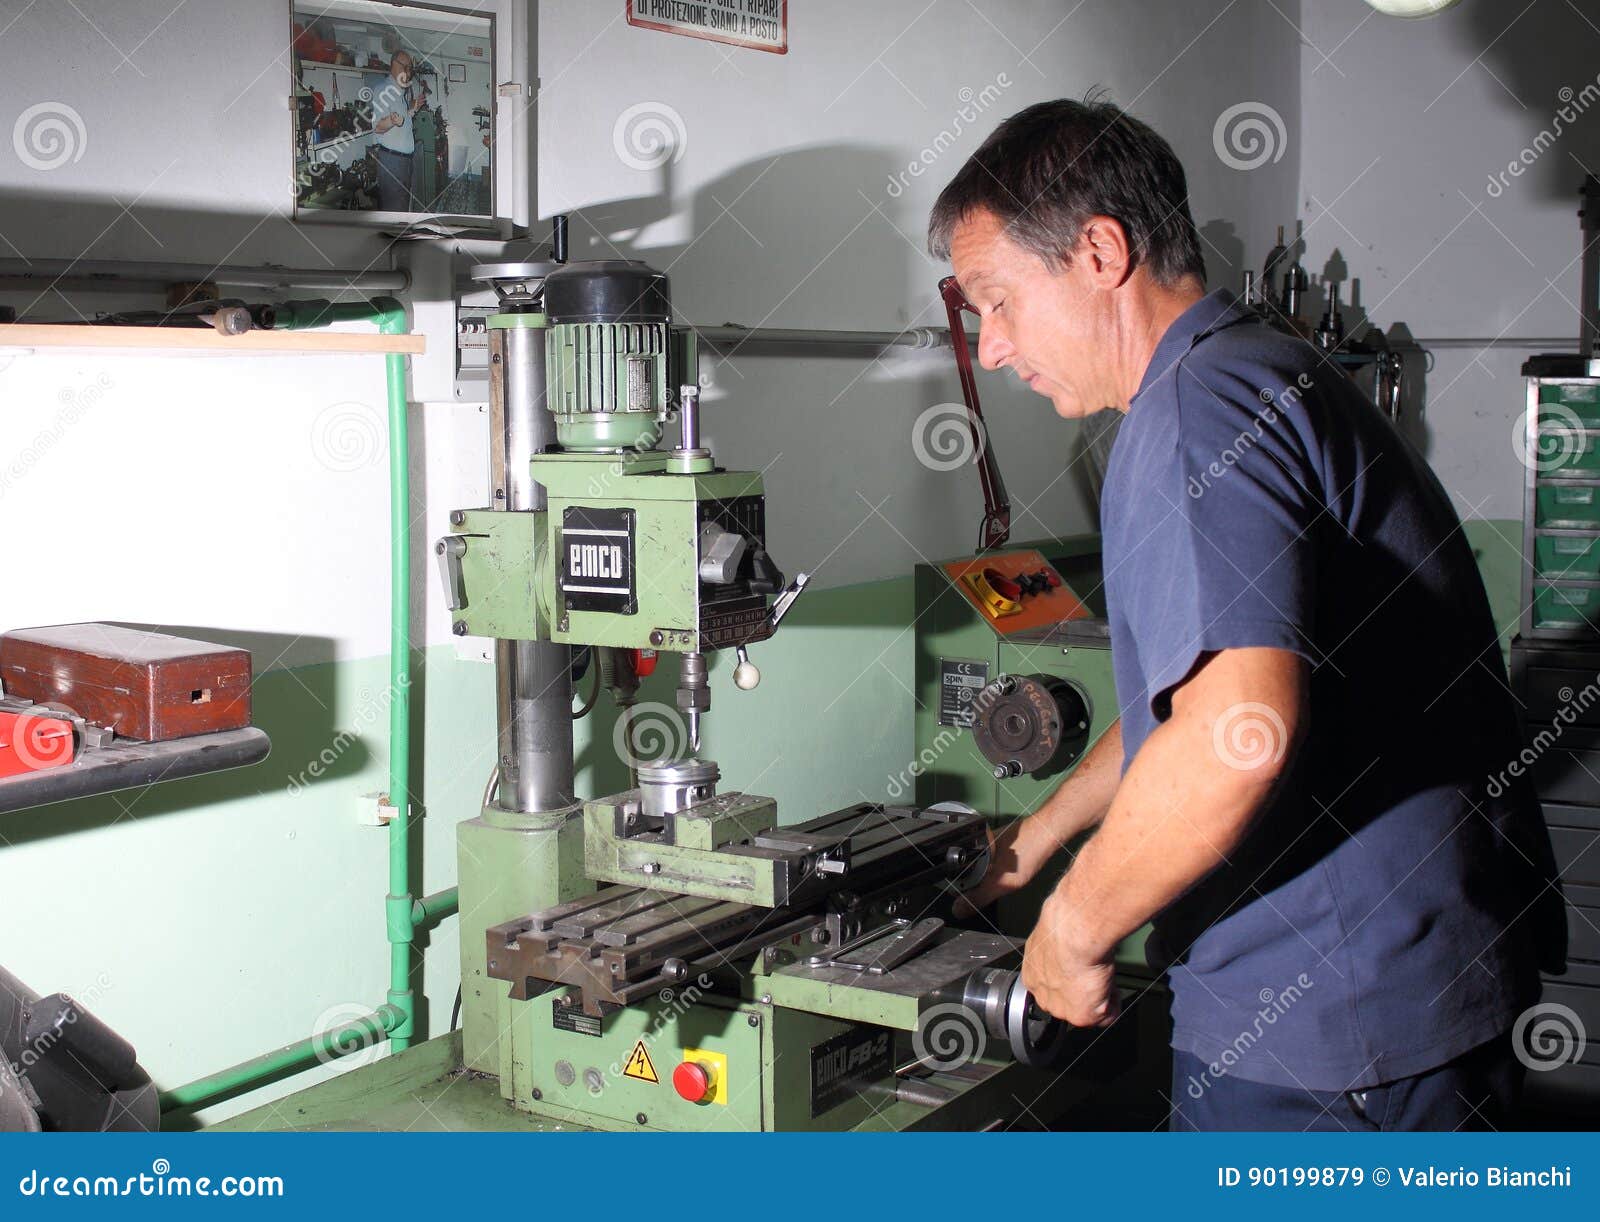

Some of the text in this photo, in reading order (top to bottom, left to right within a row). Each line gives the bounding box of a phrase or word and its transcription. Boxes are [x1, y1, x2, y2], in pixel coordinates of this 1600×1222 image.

[638, 0, 778, 41] DI PROTEZIONE SIANO A POSTO
[747, 0, 778, 18] RIPARI
